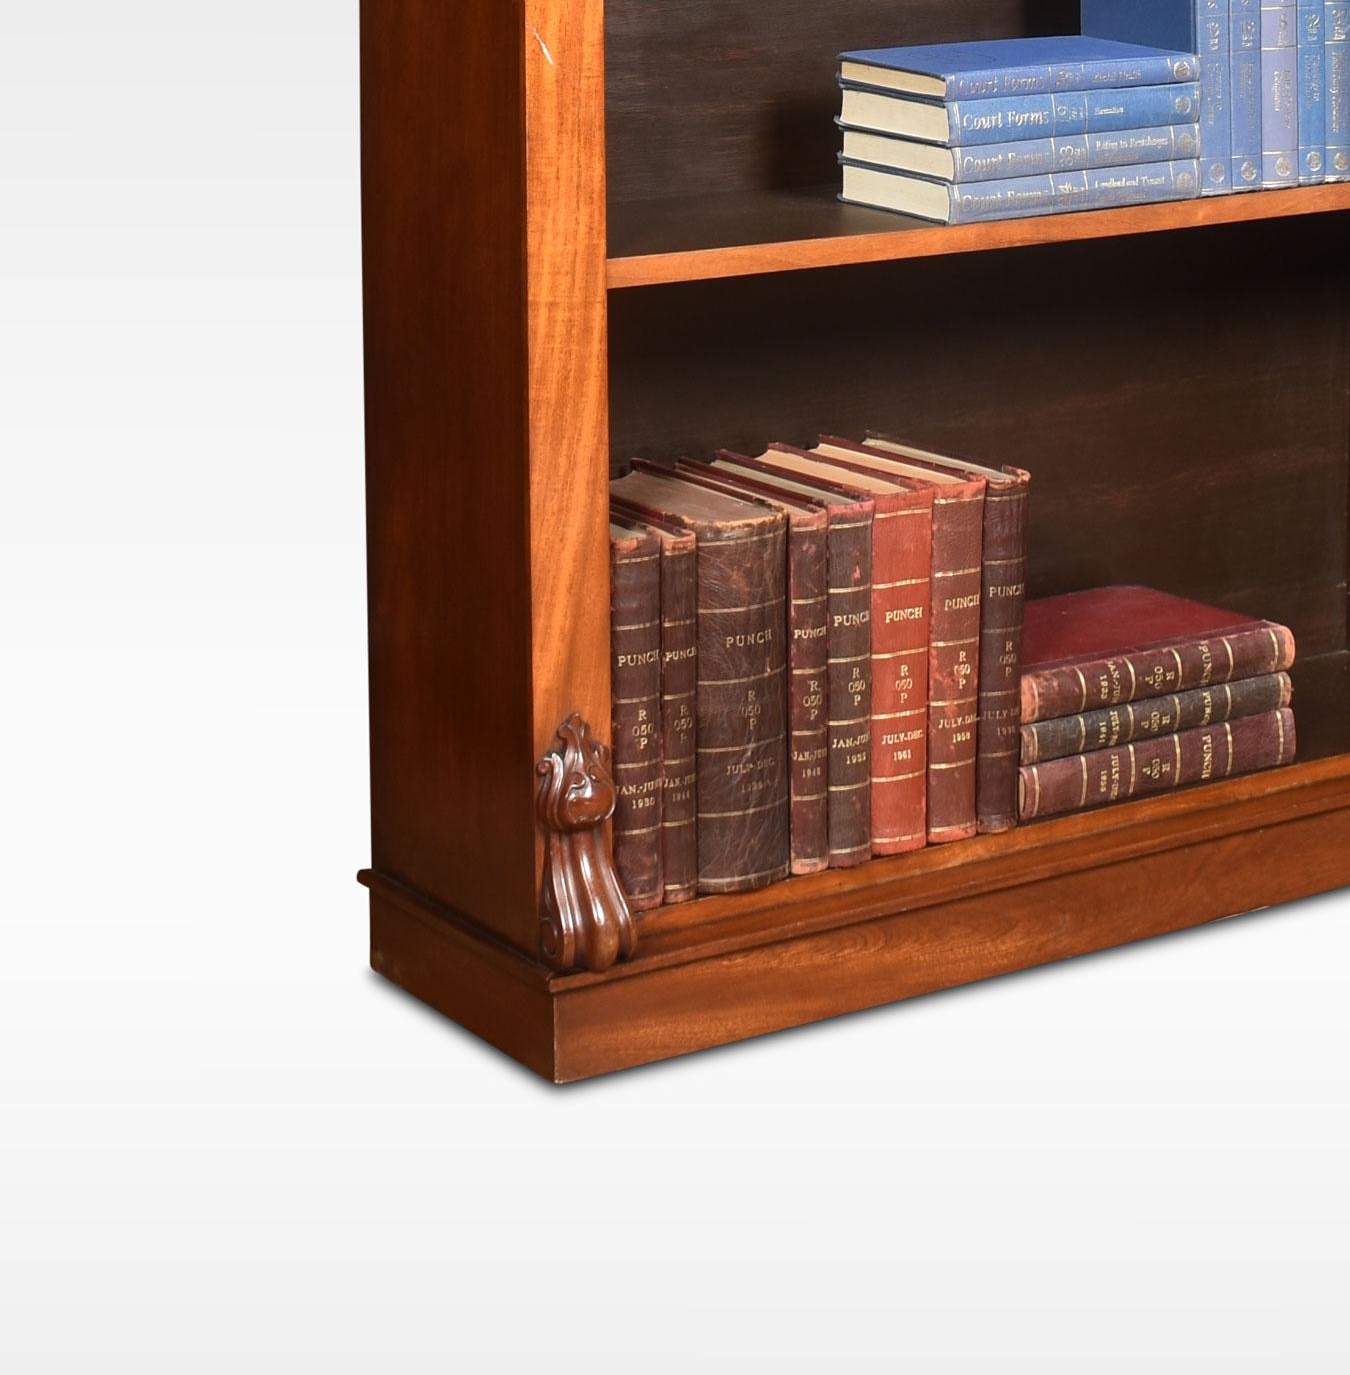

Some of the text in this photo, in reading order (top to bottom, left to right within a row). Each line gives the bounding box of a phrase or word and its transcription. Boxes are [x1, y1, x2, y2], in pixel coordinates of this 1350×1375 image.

[963, 111, 1049, 130] Court Forms
[963, 153, 1003, 173] Court
[944, 593, 980, 611] PUNCH
[884, 607, 923, 624] PUNCH
[726, 629, 773, 648] PUNCH
[1005, 641, 1013, 651] R
[618, 649, 660, 667] PUNCH
[959, 651, 967, 662] R
[852, 667, 860, 678] R
[900, 664, 909, 677] R
[1166, 671, 1175, 681] R
[959, 678, 967, 689] P
[1145, 675, 1154, 685] P
[748, 690, 756, 702] R
[854, 695, 861, 706] P
[900, 694, 908, 704] P
[638, 710, 647, 721] R
[1162, 715, 1171, 725] R
[1141, 720, 1149, 730] P
[639, 738, 648, 749] P
[1201, 735, 1213, 779] PUNCH
[1143, 767, 1151, 775] P
[1162, 763, 1171, 772] R
